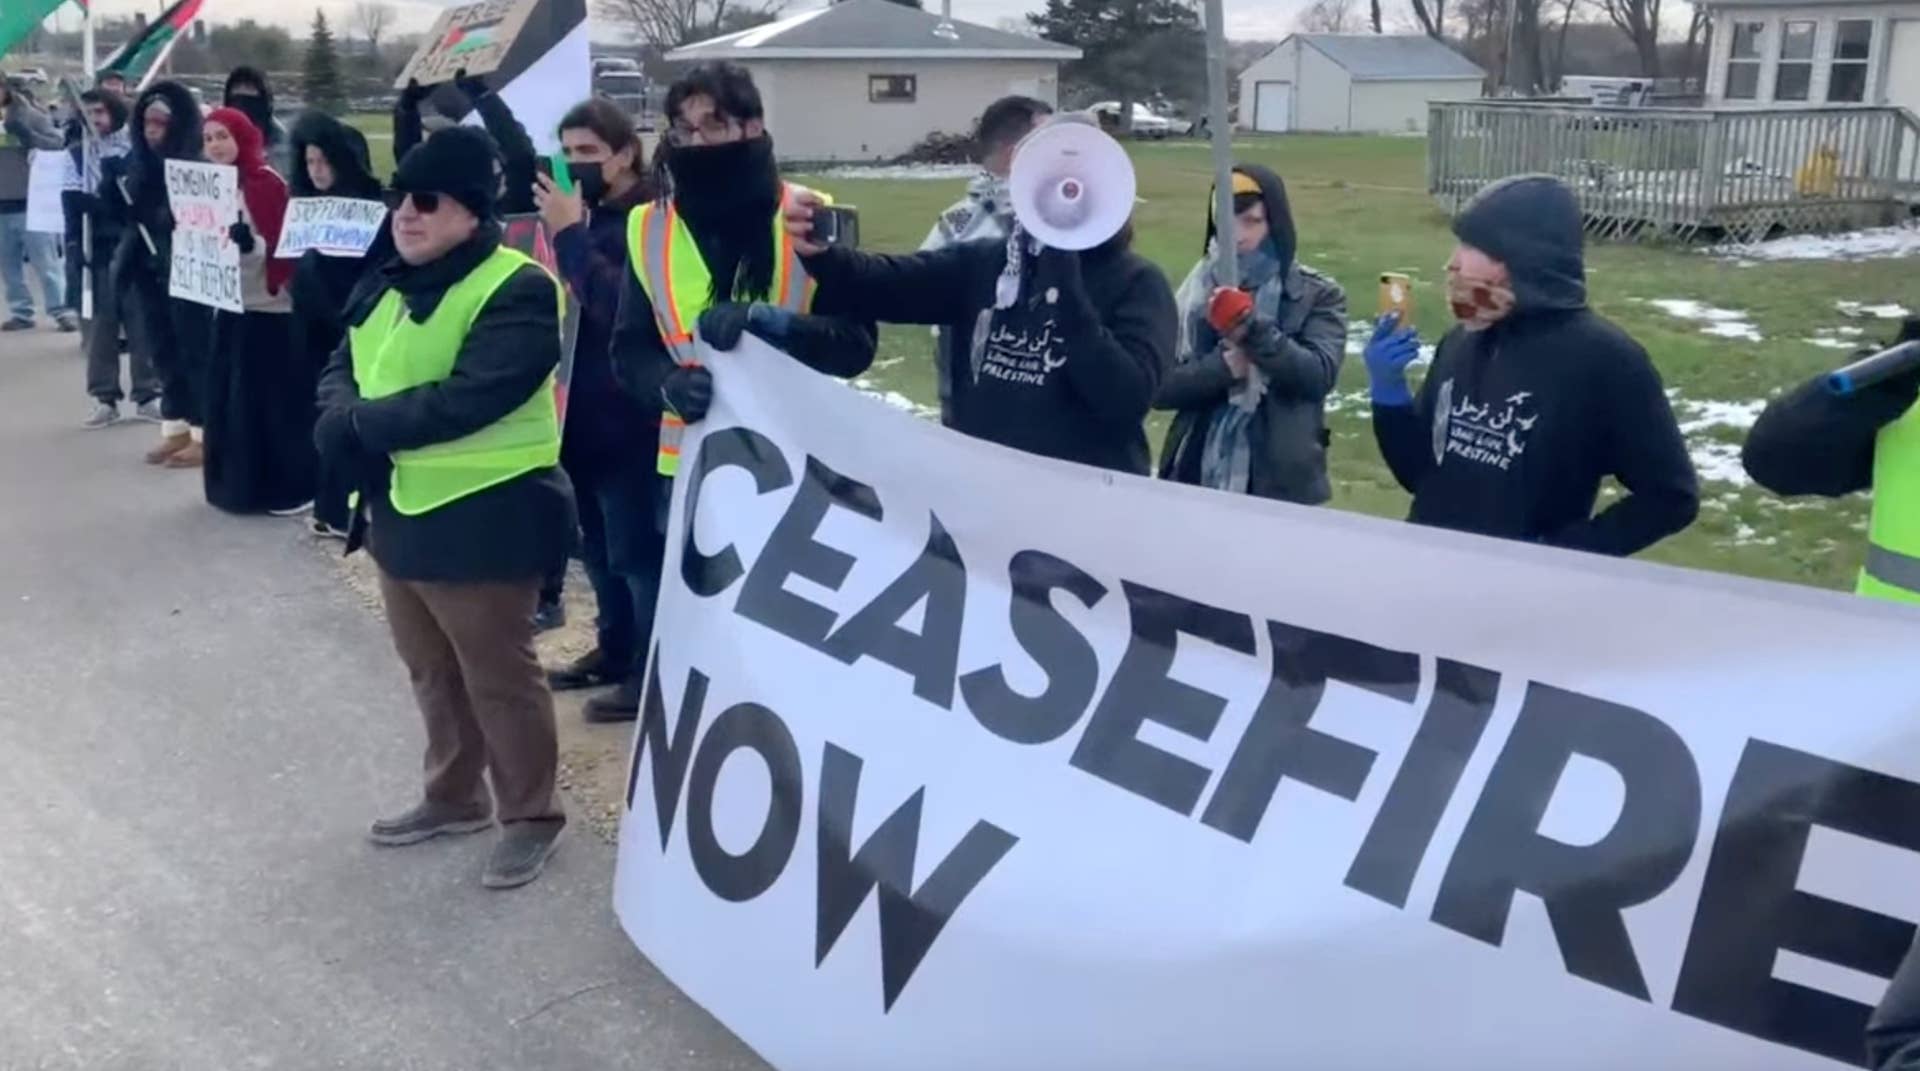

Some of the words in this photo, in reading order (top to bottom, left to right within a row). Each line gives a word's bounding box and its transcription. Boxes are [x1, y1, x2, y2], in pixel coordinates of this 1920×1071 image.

[447, 0, 518, 25] FREE
[169, 165, 220, 200] BOMBING
[982, 361, 1044, 386] PALESTINE
[1446, 439, 1512, 471] PALESTINE
[680, 426, 1920, 1068] CEASEFIRE
[627, 637, 1020, 1015] NOW
